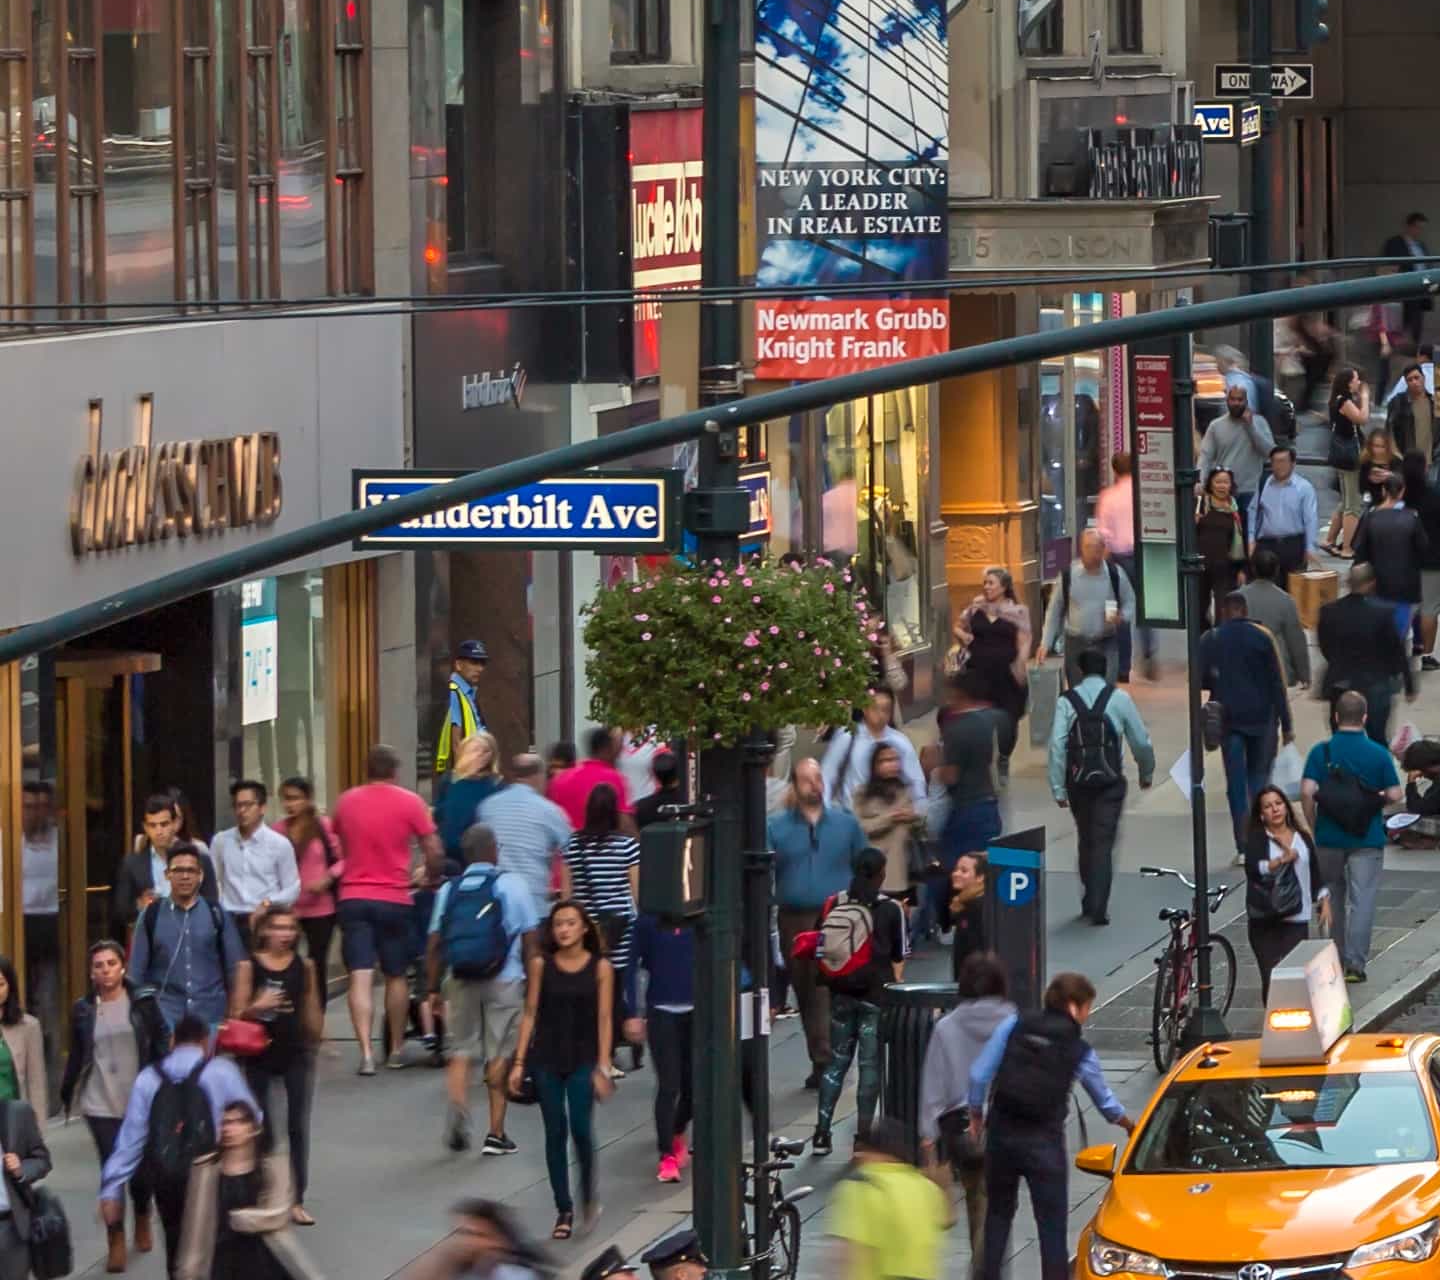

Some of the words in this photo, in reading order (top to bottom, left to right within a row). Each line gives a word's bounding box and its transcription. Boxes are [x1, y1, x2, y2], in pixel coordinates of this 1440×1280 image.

[1195, 112, 1231, 131] Ave
[760, 170, 813, 187] NEW
[820, 169, 880, 187] YORK
[888, 168, 945, 186] CITY:
[799, 195, 813, 211] A
[819, 193, 908, 211] LEADER
[767, 218, 793, 235] IN
[800, 217, 858, 234] REAL
[864, 216, 942, 233] ESTATE
[758, 308, 869, 330] Newmark
[875, 307, 946, 330] Grubb
[757, 336, 835, 364] Knight
[842, 336, 906, 358] Frank
[368, 494, 573, 530] nderbilt
[582, 495, 657, 528] Ave
[1010, 872, 1029, 900] P
